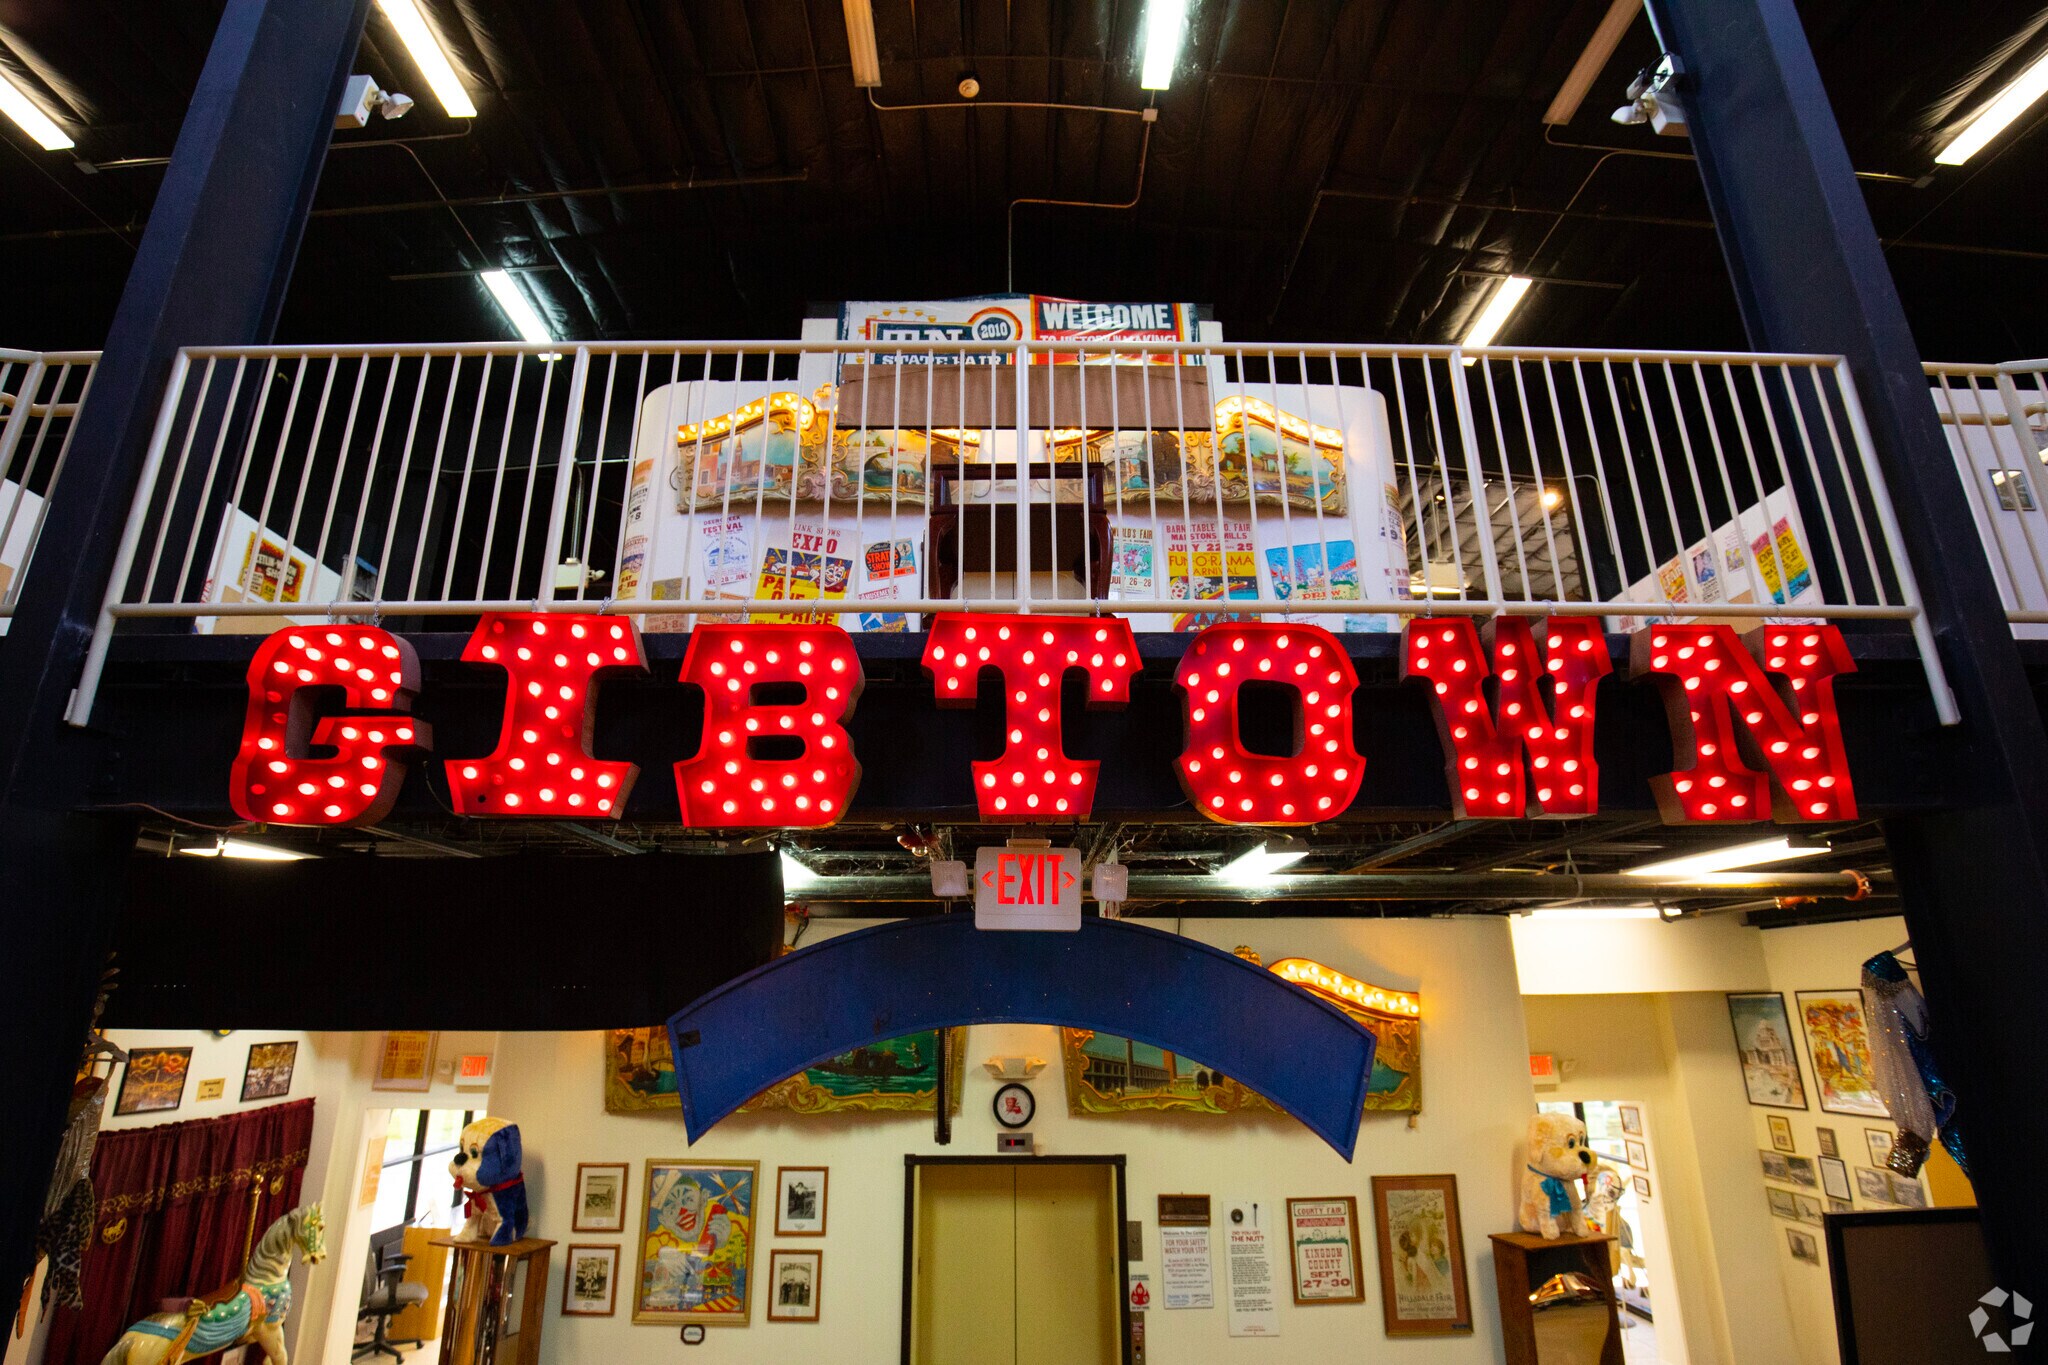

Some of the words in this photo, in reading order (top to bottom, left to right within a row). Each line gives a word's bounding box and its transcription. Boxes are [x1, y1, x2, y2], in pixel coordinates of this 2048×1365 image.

[1043, 302, 1172, 329] WELCOME
[980, 323, 1009, 339] 2010
[703, 522, 743, 534] FESTVAL
[1166, 523, 1215, 534] BARNTABLE
[1234, 523, 1251, 532] FAIR
[792, 532, 838, 554] EXPO
[1237, 543, 1253, 551] 25
[866, 550, 899, 564] STRATS
[872, 561, 897, 571] SHOW
[1129, 577, 1138, 586] 26
[1144, 579, 1152, 587] 28
[230, 612, 1859, 828] GIBTOWN
[997, 853, 1064, 905] EXIT
[461, 1055, 488, 1077] EXIT
[1297, 1206, 1324, 1215] COUNTY
[1327, 1206, 1342, 1214] FAIR
[1305, 1248, 1342, 1258] KINGDOM
[1308, 1259, 1342, 1270] COUNTY
[1303, 1279, 1322, 1288] 27
[1331, 1278, 1350, 1287] 30
